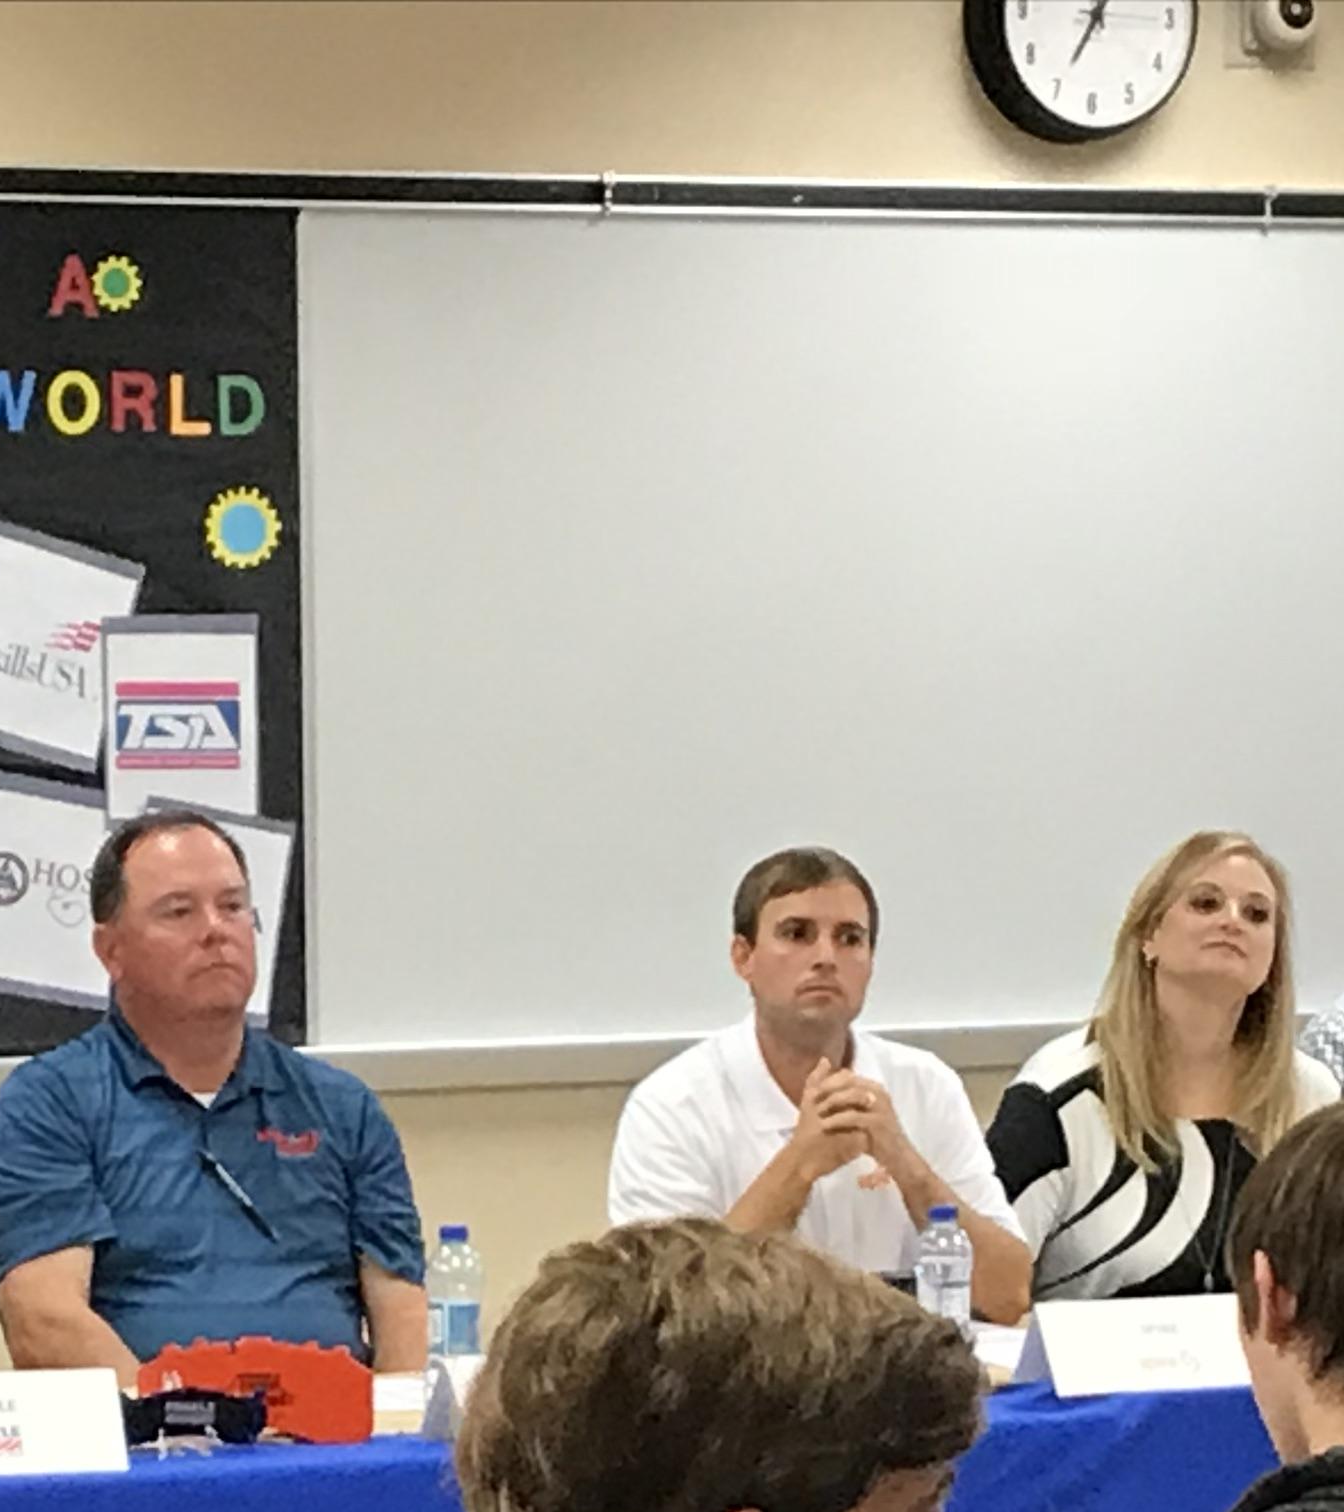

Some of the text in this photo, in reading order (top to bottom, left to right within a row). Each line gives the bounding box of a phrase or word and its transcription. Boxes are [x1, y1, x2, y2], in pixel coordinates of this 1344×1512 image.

[1165, 7, 1174, 30] 3
[1026, 42, 1035, 65] 8
[1153, 52, 1162, 72] 4
[1052, 78, 1061, 100] 7
[1124, 82, 1134, 105] 5
[1087, 92, 1097, 115] 6
[48, 254, 99, 318] A
[118, 704, 240, 750] TSA
